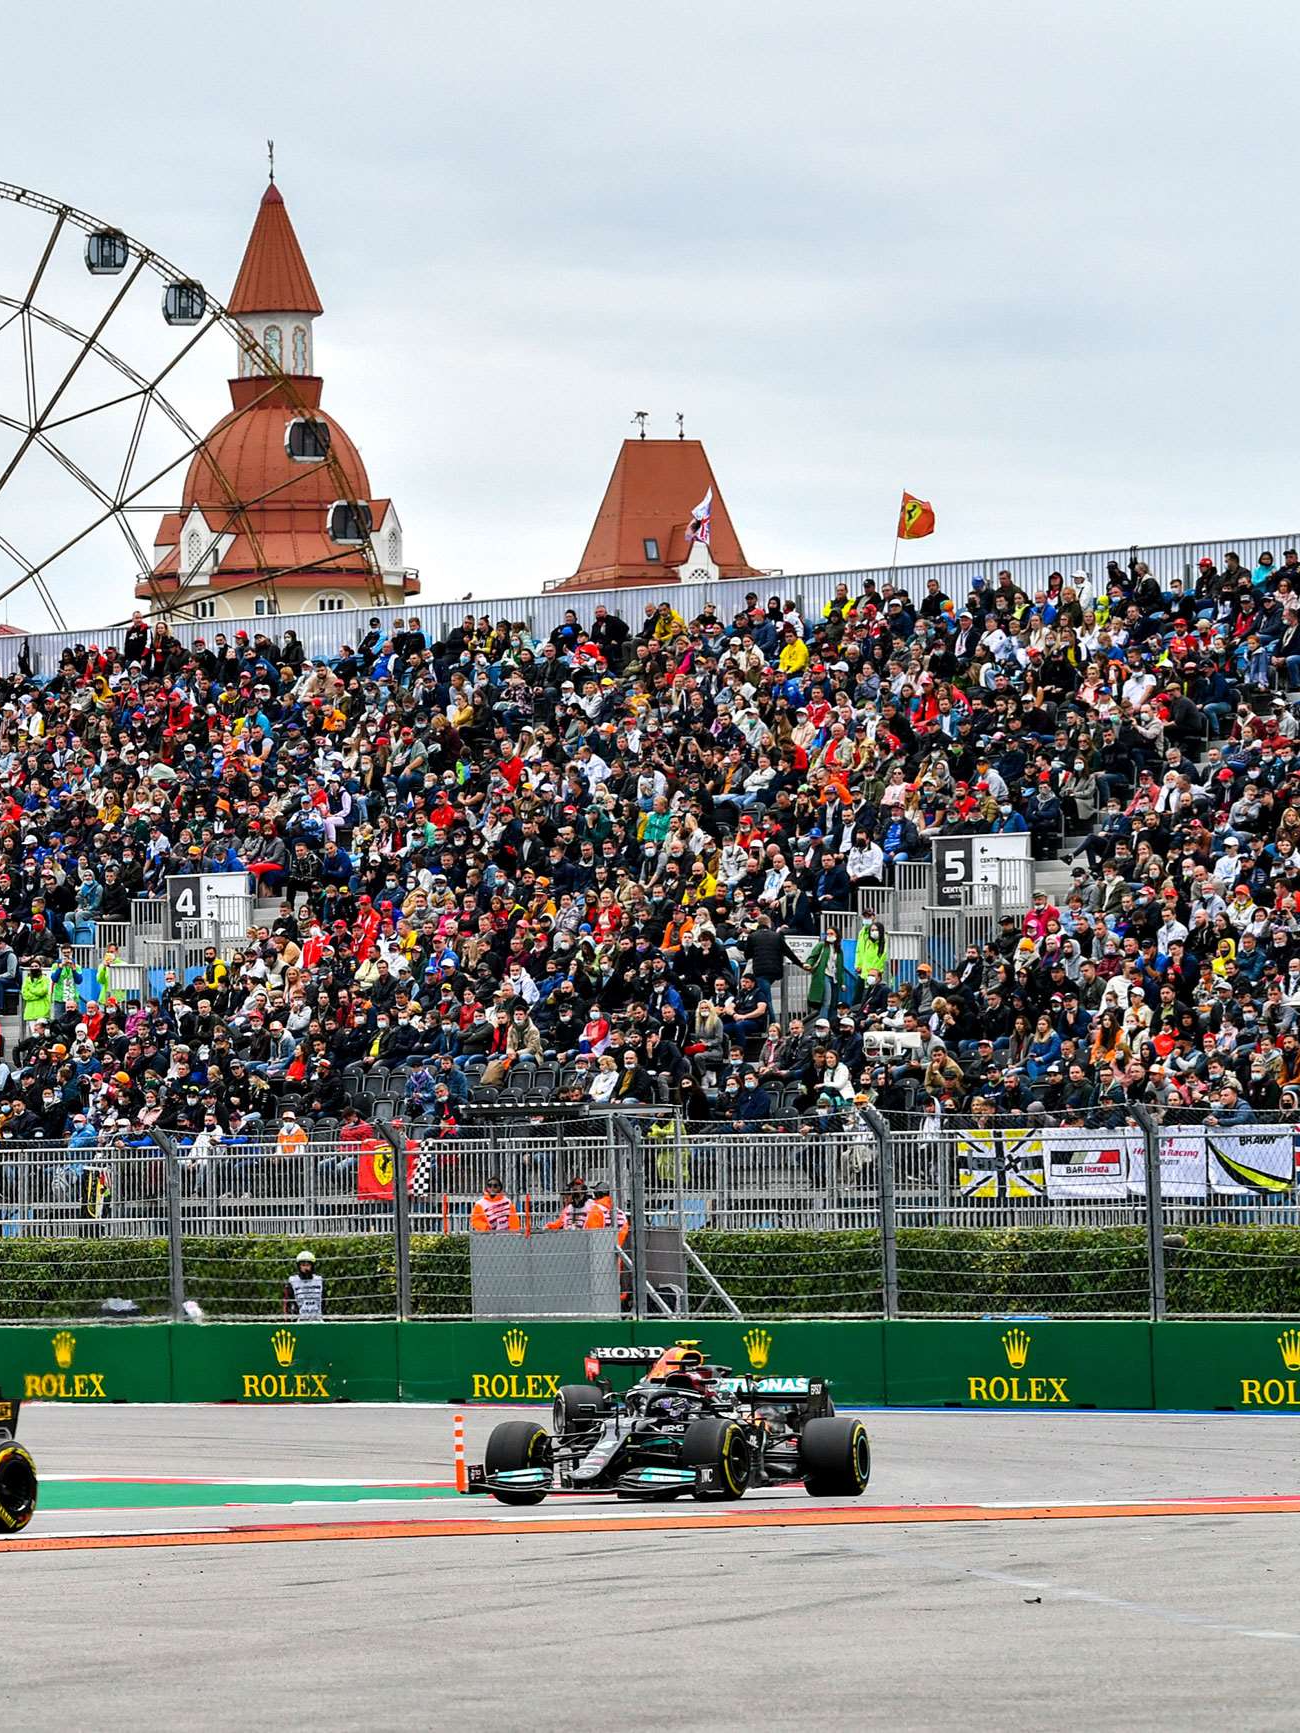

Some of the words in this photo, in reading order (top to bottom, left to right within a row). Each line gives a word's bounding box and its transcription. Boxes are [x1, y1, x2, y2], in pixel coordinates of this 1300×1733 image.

[945, 850, 965, 881] 5
[175, 888, 196, 916] 4
[1239, 1134, 1276, 1146] BRAWN
[1066, 1166, 1084, 1174] BAR
[596, 1346, 665, 1359] HOND
[24, 1374, 107, 1398] ROLEX
[243, 1374, 329, 1397] ROLEX
[473, 1374, 560, 1398] ROLEX
[968, 1376, 1070, 1402] ROLEX
[1240, 1379, 1300, 1404] ROL
